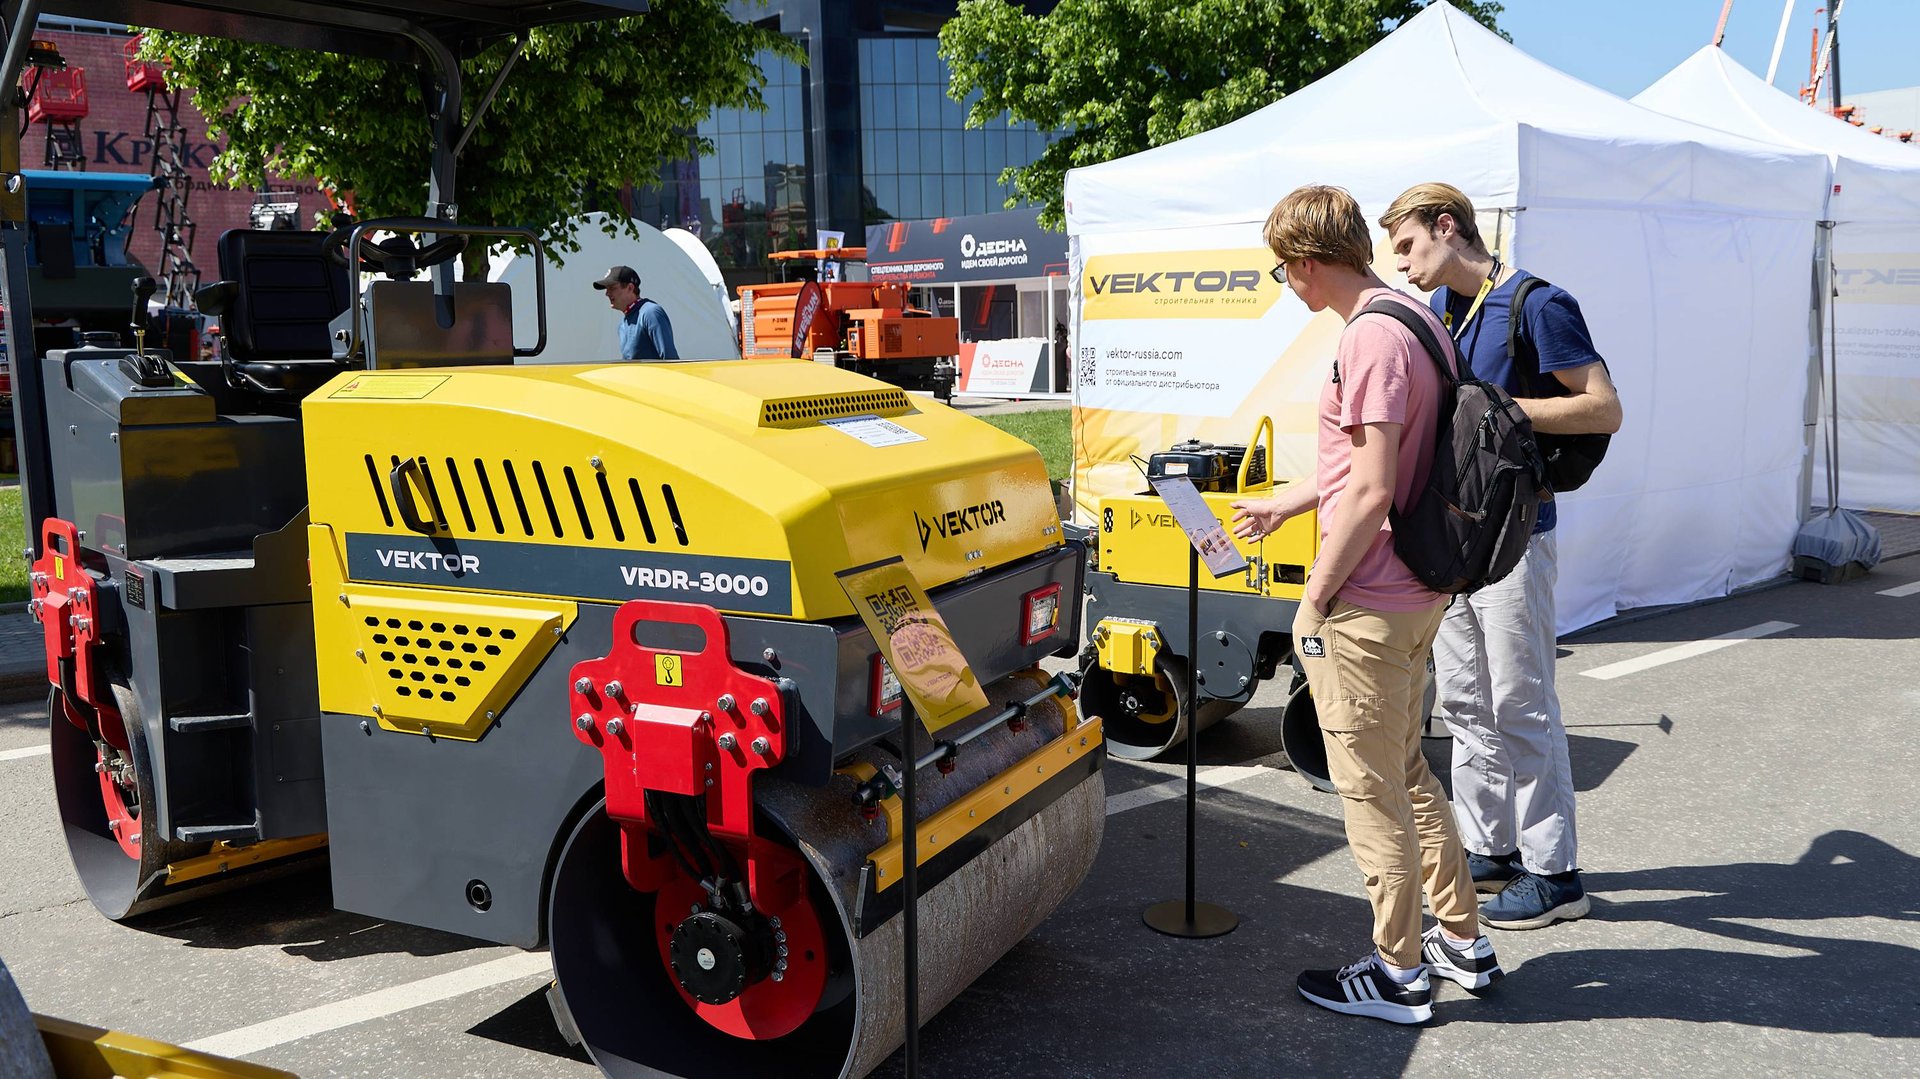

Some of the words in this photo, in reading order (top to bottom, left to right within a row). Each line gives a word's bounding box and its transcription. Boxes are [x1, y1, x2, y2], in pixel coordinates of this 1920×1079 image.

[976, 239, 1027, 257] ДЕСНА
[961, 259, 977, 269] ИДЕМ
[978, 256, 998, 267] СВОЕЙ
[998, 254, 1028, 267] ДОРОГОЙ
[1090, 270, 1261, 295] VEKTOR
[1154, 297, 1214, 306] строительная
[1106, 348, 1183, 360] vektor-russia.com
[992, 360, 1024, 368] ДЕСНА
[1105, 368, 1147, 379] строительная
[1149, 370, 1177, 378] техника
[1113, 378, 1157, 388] официального
[1159, 379, 1220, 391] дистрибьютора
[932, 499, 1006, 538] VEKTOR
[376, 548, 480, 574] VEKTOR
[619, 565, 769, 597] VRDR-3000
